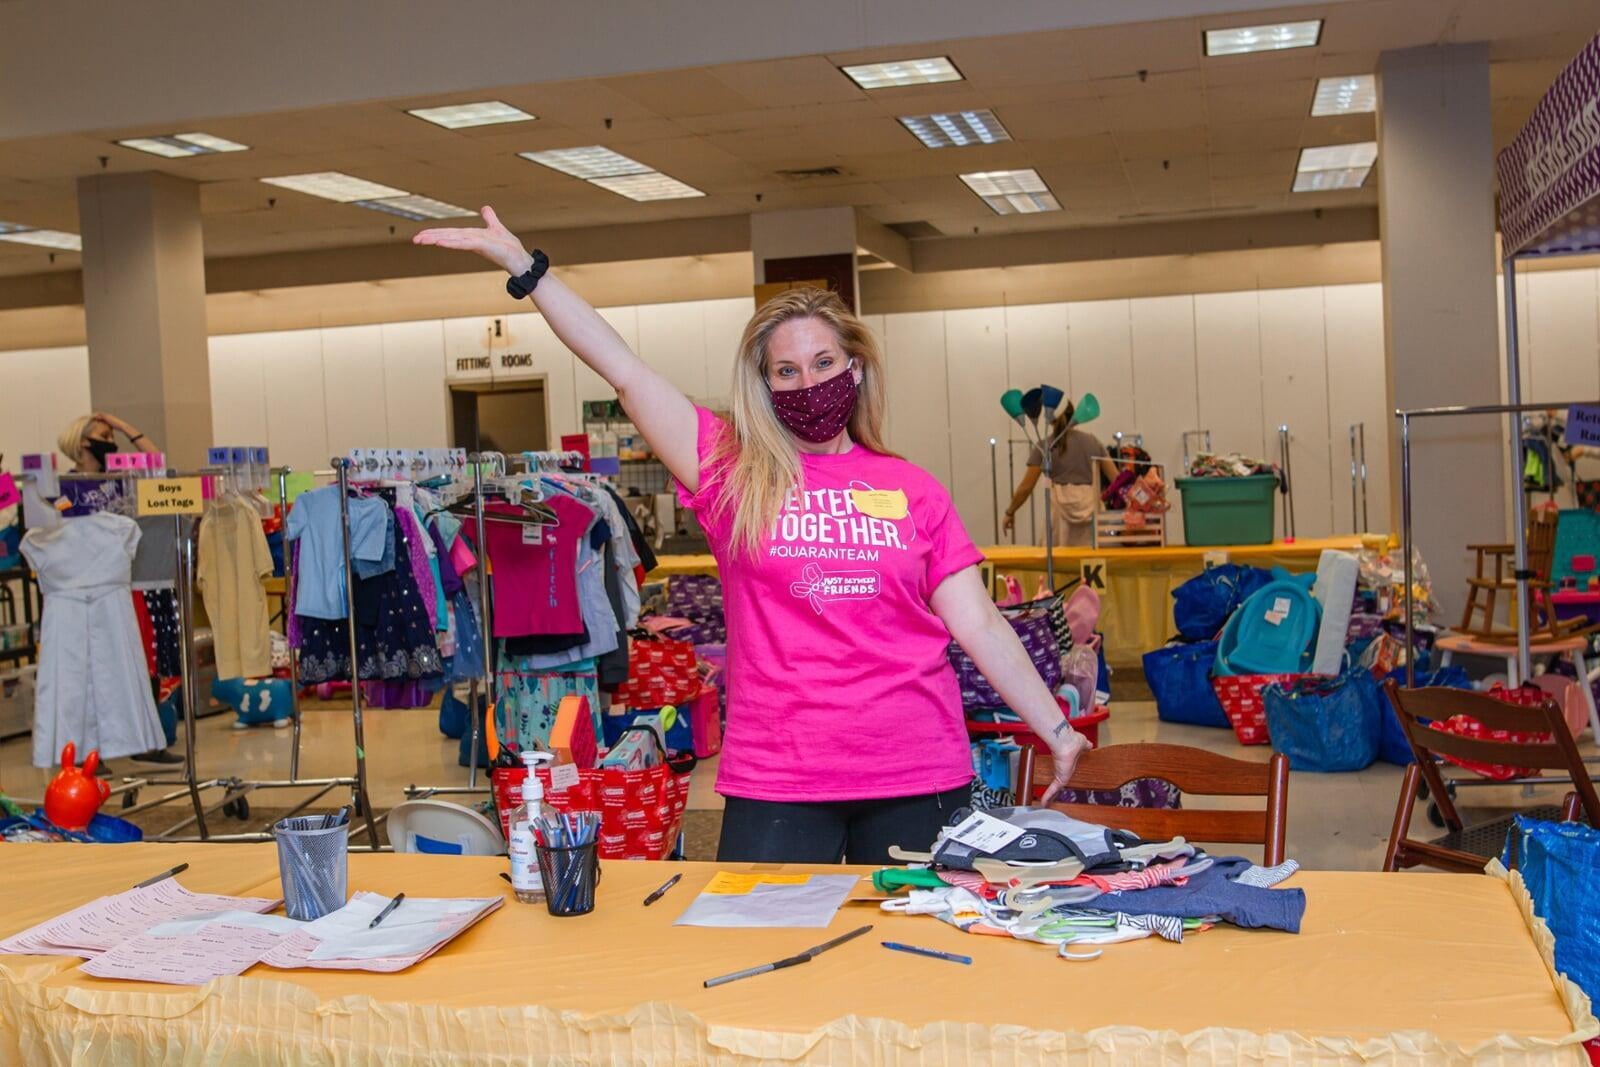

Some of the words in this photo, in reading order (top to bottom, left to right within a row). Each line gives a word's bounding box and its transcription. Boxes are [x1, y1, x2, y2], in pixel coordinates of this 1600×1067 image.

[456, 357, 490, 370] FITTING
[501, 354, 532, 367] ROOMS
[158, 484, 182, 493] Boys
[147, 499, 169, 507] Lost
[171, 498, 194, 508] Tags
[784, 488, 860, 517] ETTER
[769, 545, 879, 561] #QUARANTEAM
[822, 577, 842, 585] JUST
[1083, 564, 1105, 589] K
